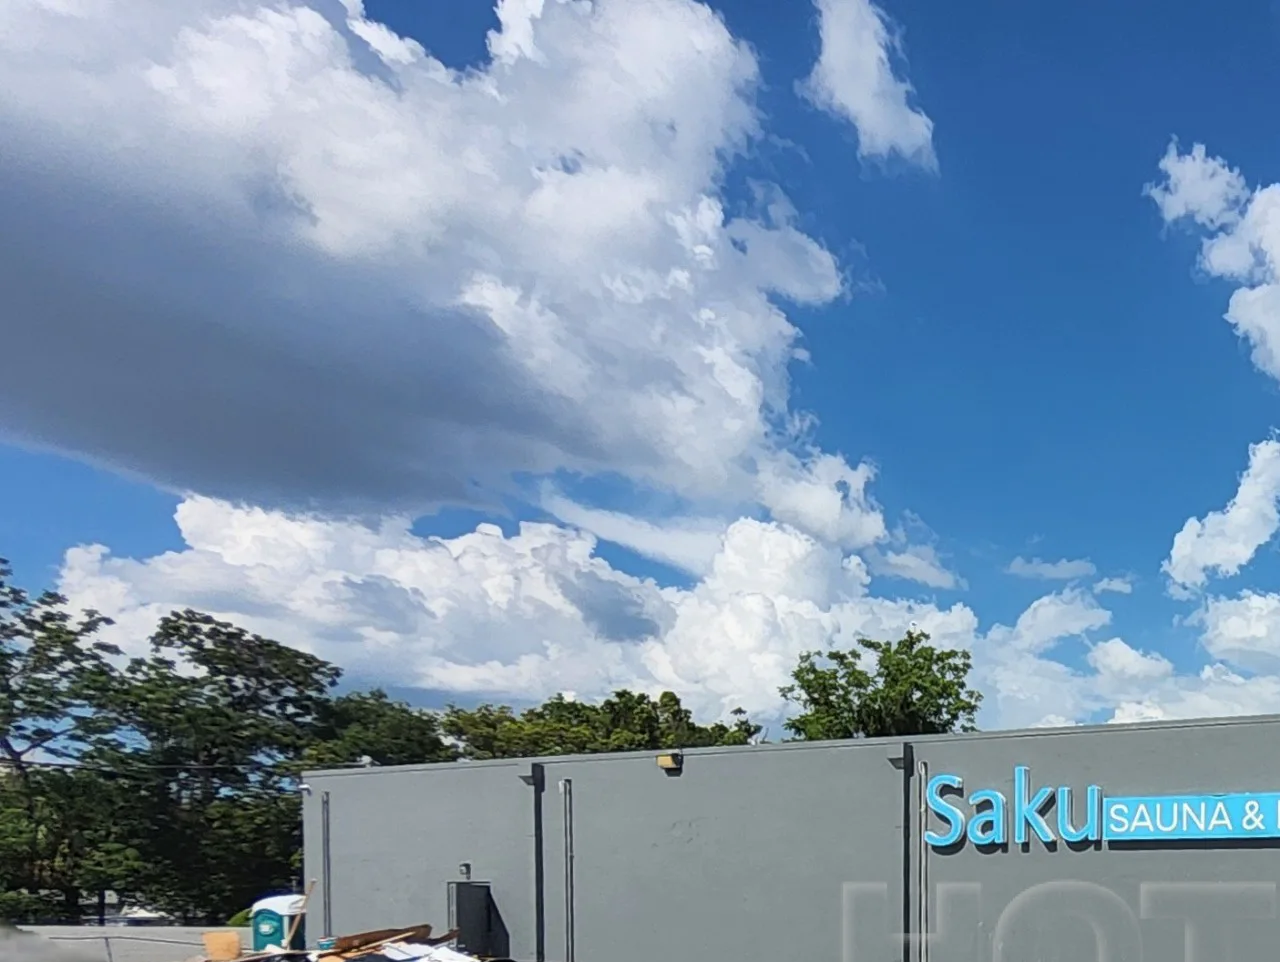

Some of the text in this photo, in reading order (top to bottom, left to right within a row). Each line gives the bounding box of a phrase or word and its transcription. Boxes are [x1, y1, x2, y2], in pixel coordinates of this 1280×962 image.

[924, 766, 1103, 846] Saku
[1109, 801, 1233, 833] SAUNA
[1242, 800, 1265, 831] &
